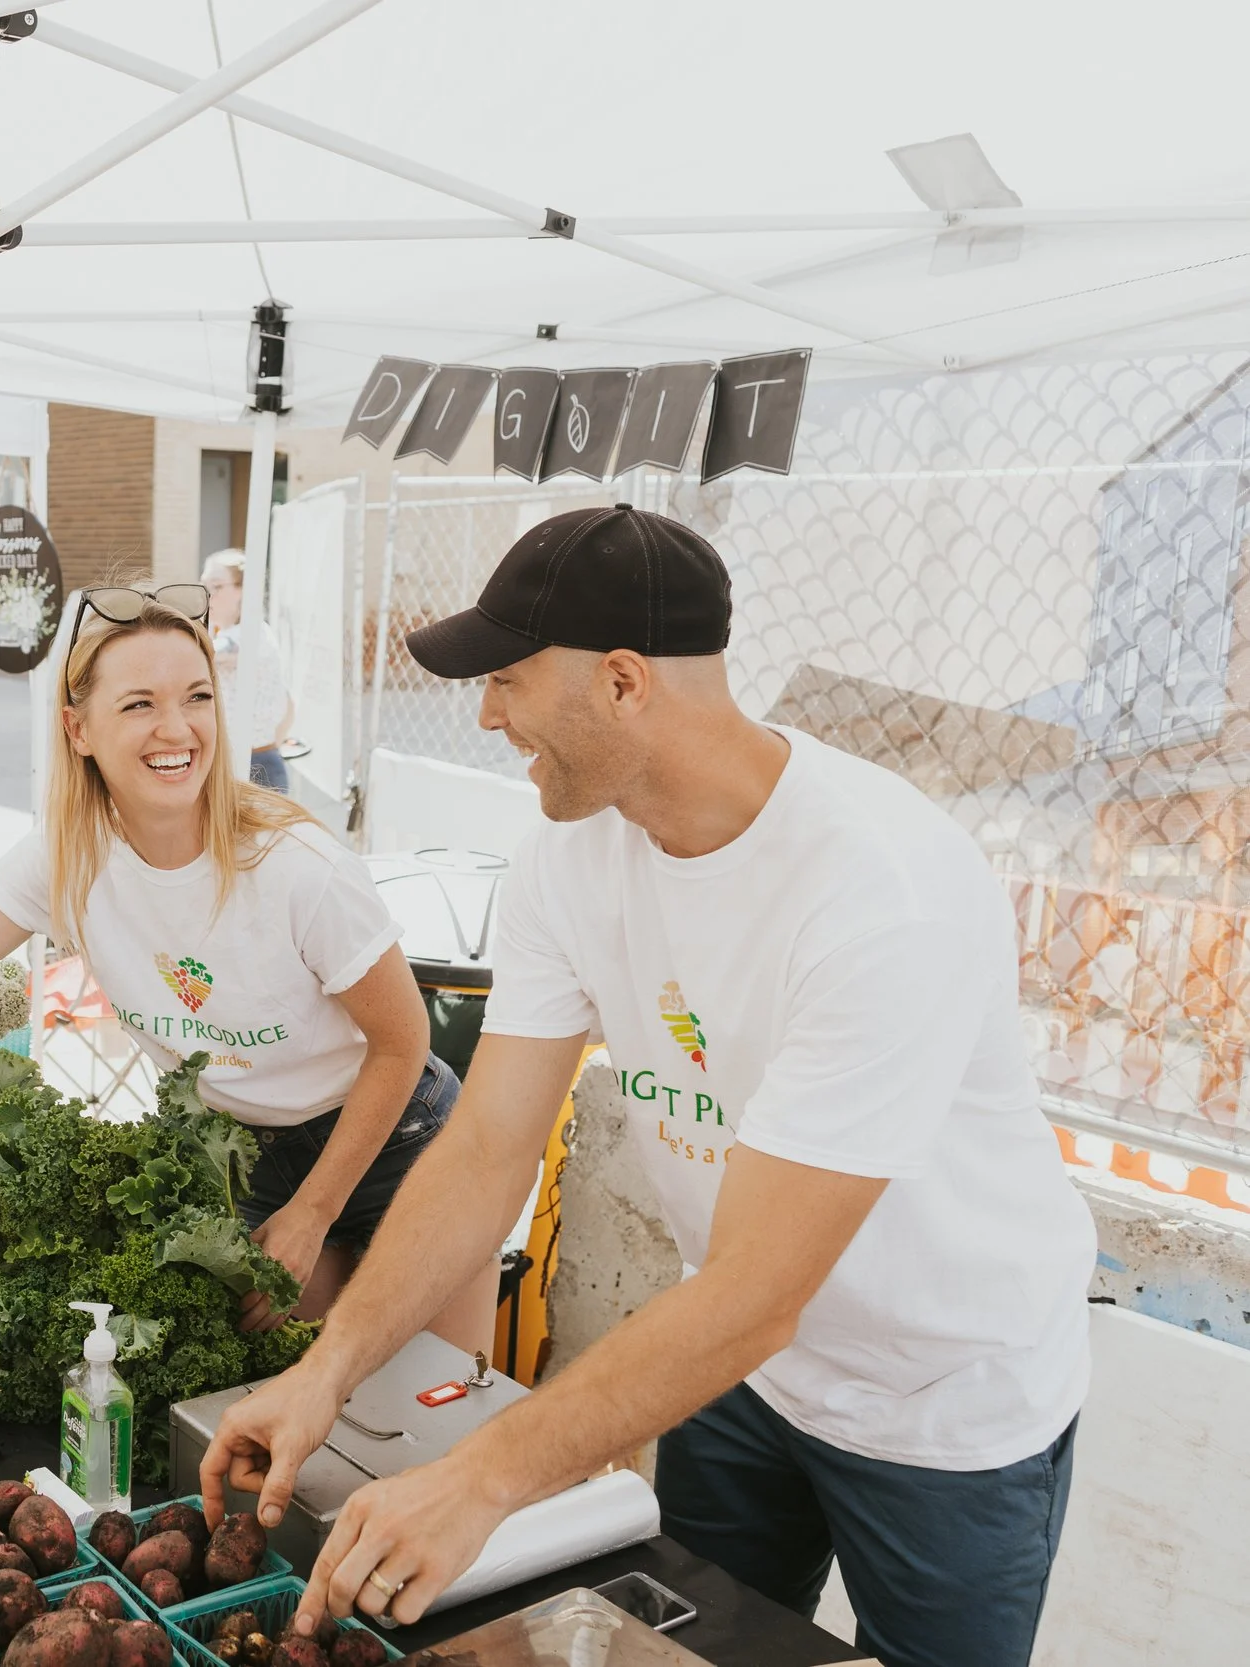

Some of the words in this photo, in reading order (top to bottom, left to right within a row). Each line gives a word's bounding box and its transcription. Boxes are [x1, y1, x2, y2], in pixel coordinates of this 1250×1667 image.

[357, 371, 527, 441] DIG
[650, 377, 786, 442] IT
[154, 1016, 174, 1037] IT
[182, 1018, 290, 1048] PRODUCE
[613, 1069, 657, 1101] IG
